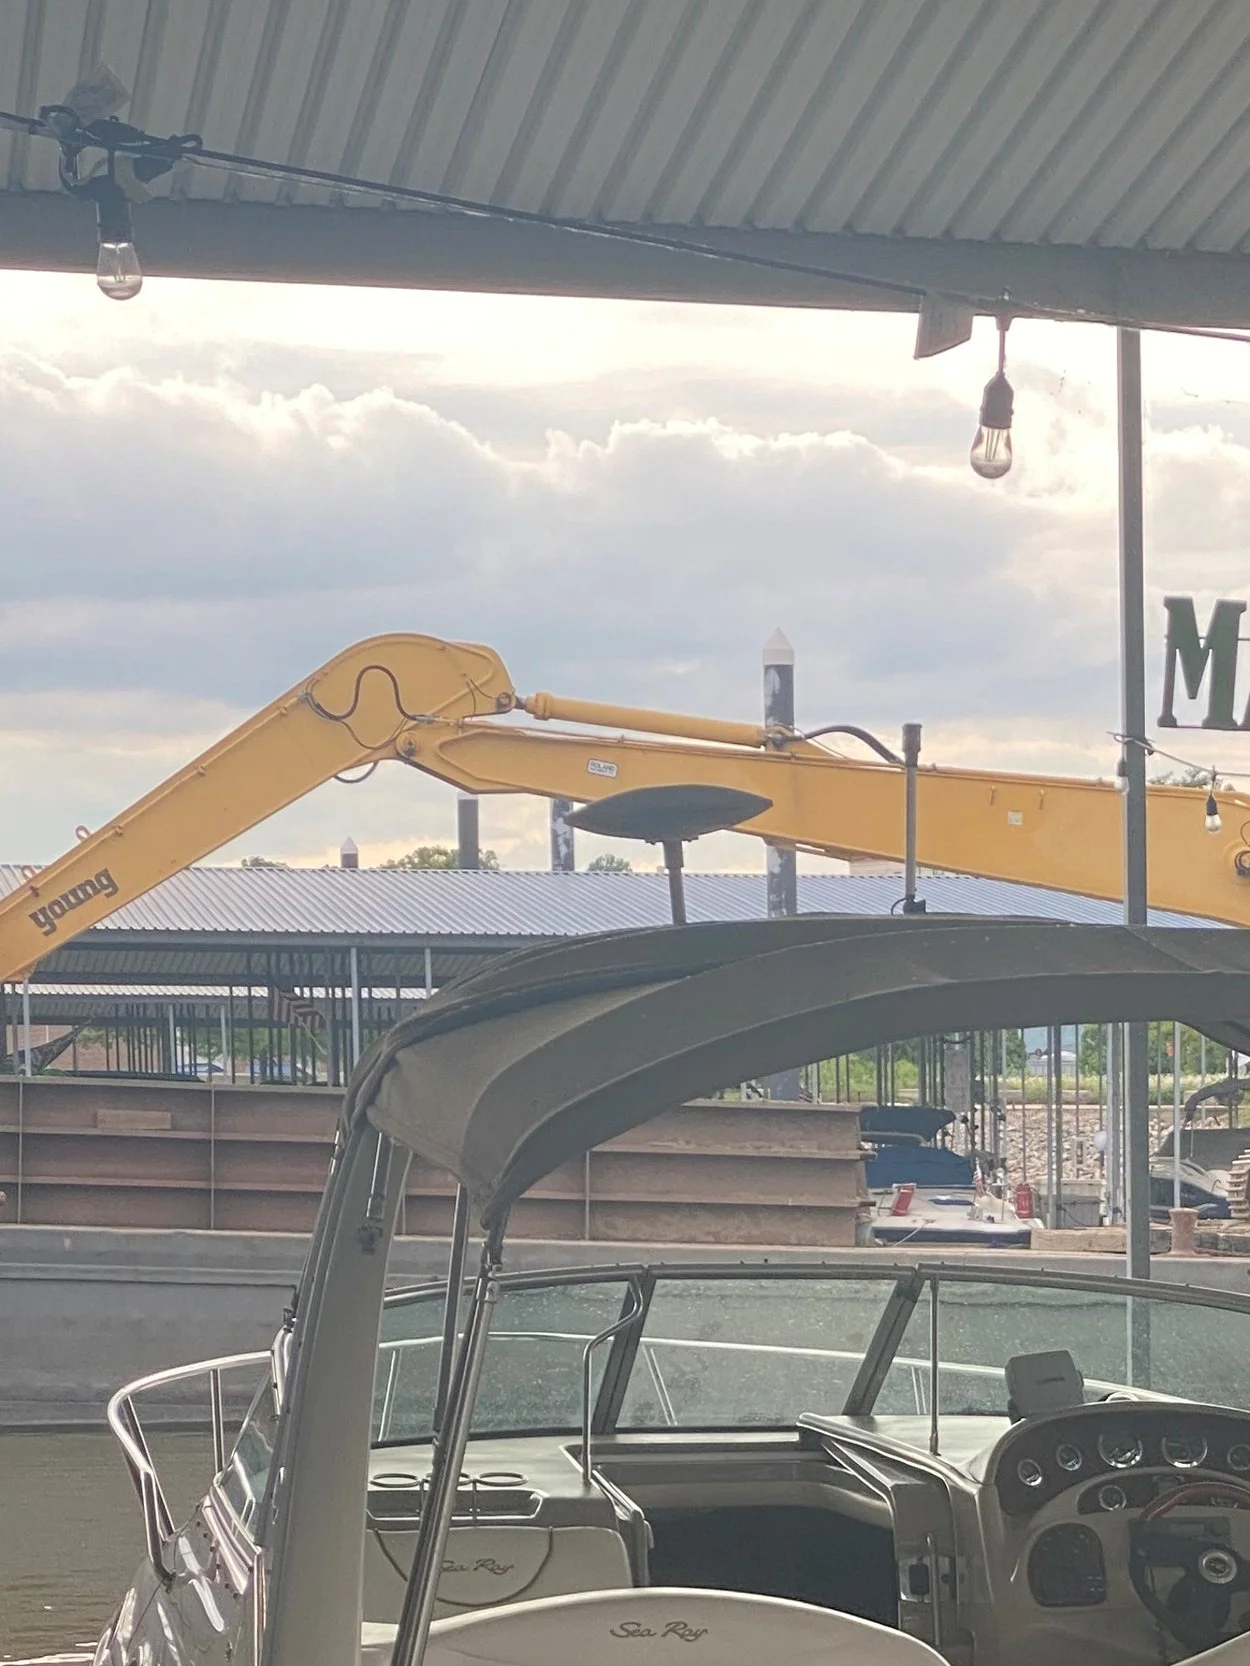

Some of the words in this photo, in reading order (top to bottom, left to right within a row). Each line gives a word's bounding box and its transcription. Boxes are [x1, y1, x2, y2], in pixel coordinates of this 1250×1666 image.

[28, 868, 119, 937] young
[472, 1558, 514, 1576] Ray
[609, 1621, 657, 1638] Sea
[661, 1621, 708, 1642] Ray
